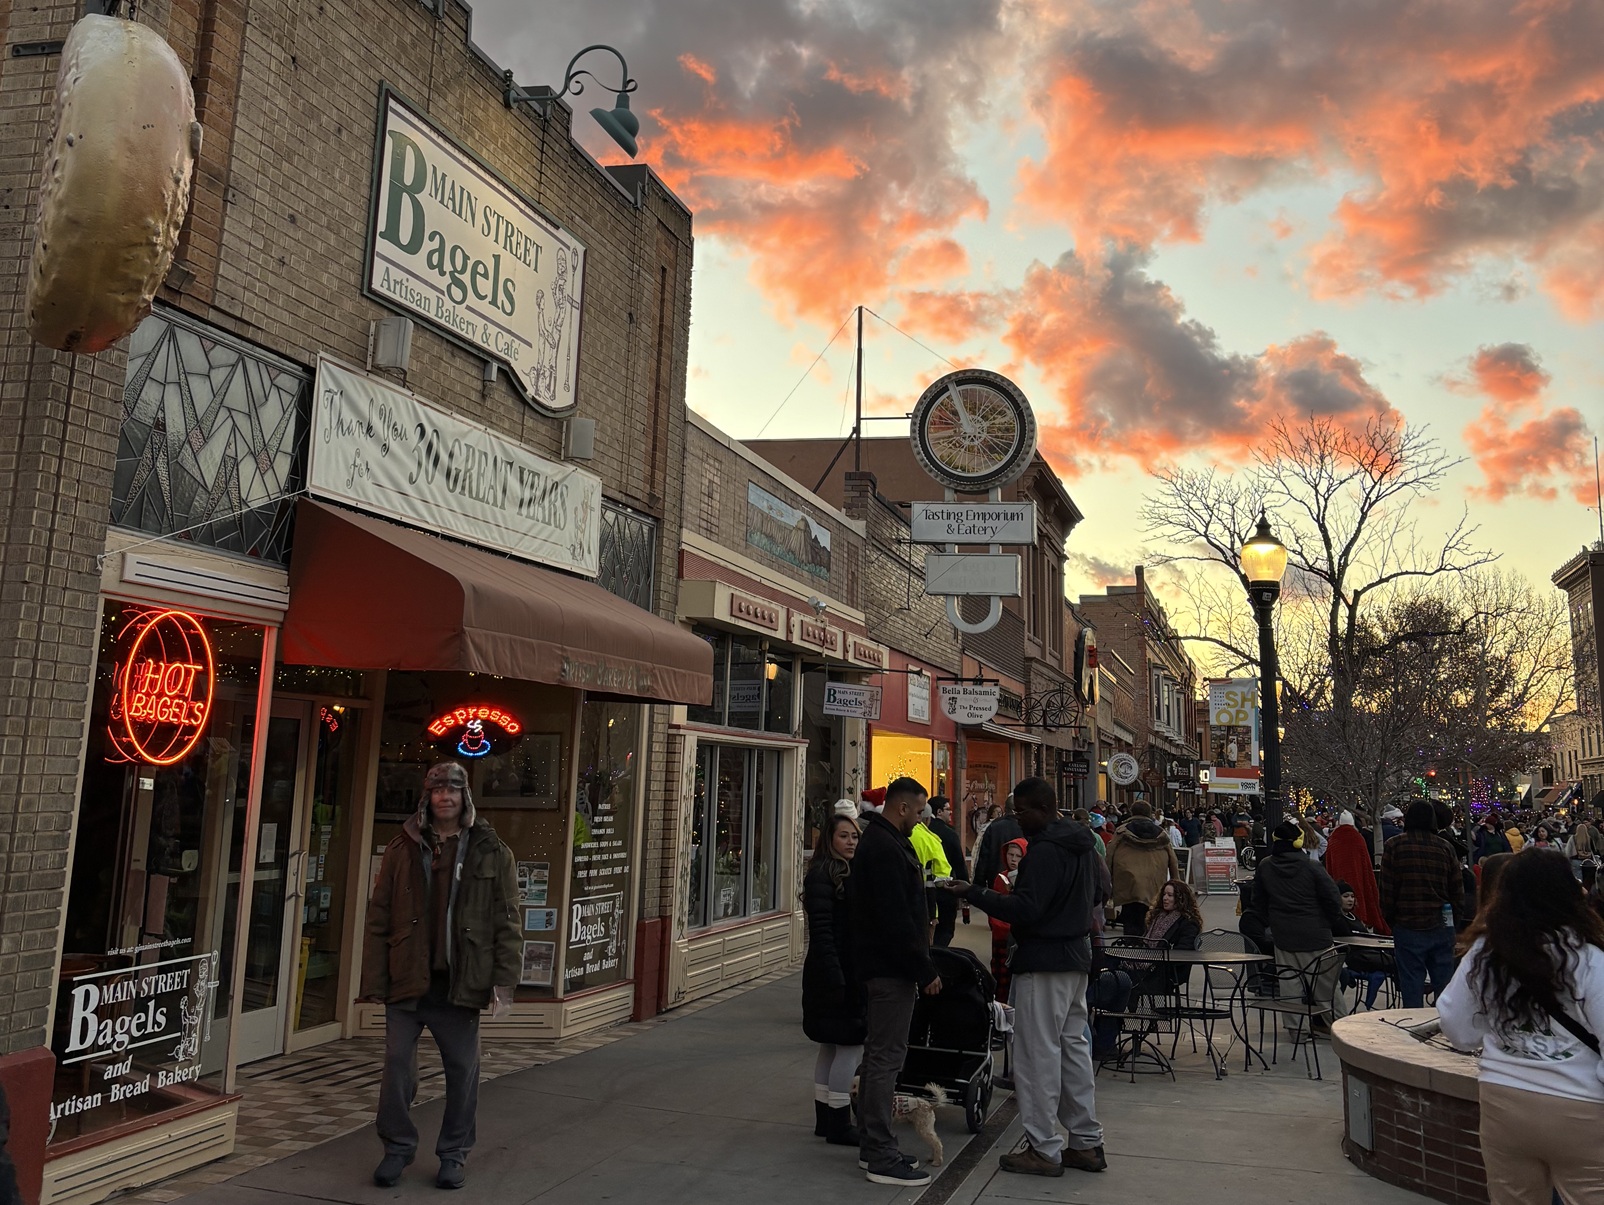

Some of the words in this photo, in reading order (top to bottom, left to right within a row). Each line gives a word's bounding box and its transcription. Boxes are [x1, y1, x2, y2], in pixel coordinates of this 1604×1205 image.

[379, 129, 516, 317] Bagels
[428, 164, 478, 228] MAIN
[482, 205, 542, 273] STREET
[380, 267, 431, 314] Artisan
[434, 297, 478, 341] Bakery
[481, 324, 491, 346] &
[323, 388, 375, 444] Thank
[379, 404, 408, 457] You
[346, 448, 371, 489] for
[408, 422, 441, 486] 30
[446, 438, 514, 511] GREAT
[517, 465, 569, 531] YEARS
[922, 509, 963, 523] Tasting
[965, 509, 1024, 523] Emporium
[946, 523, 955, 535] &
[957, 523, 998, 538] Eatery
[142, 659, 203, 696] HOT
[942, 687, 960, 695] Bella
[962, 688, 996, 696] Balsamic
[129, 693, 204, 725] BAGELS
[826, 688, 863, 707] Bagels
[427, 706, 520, 738] Espresso
[570, 903, 605, 945] Bagels
[582, 904, 595, 917] MAIN
[595, 900, 614, 915] STREET
[564, 965, 584, 979] Artisan
[586, 960, 600, 974] Bread
[602, 954, 619, 970] Bakery
[583, 949, 594, 961] and
[99, 979, 139, 1006] MAIN
[140, 968, 191, 997] STREET
[64, 983, 167, 1054] Bagels
[103, 1053, 133, 1080] and
[110, 1075, 150, 1103] Bread
[157, 1063, 202, 1089] Bakery
